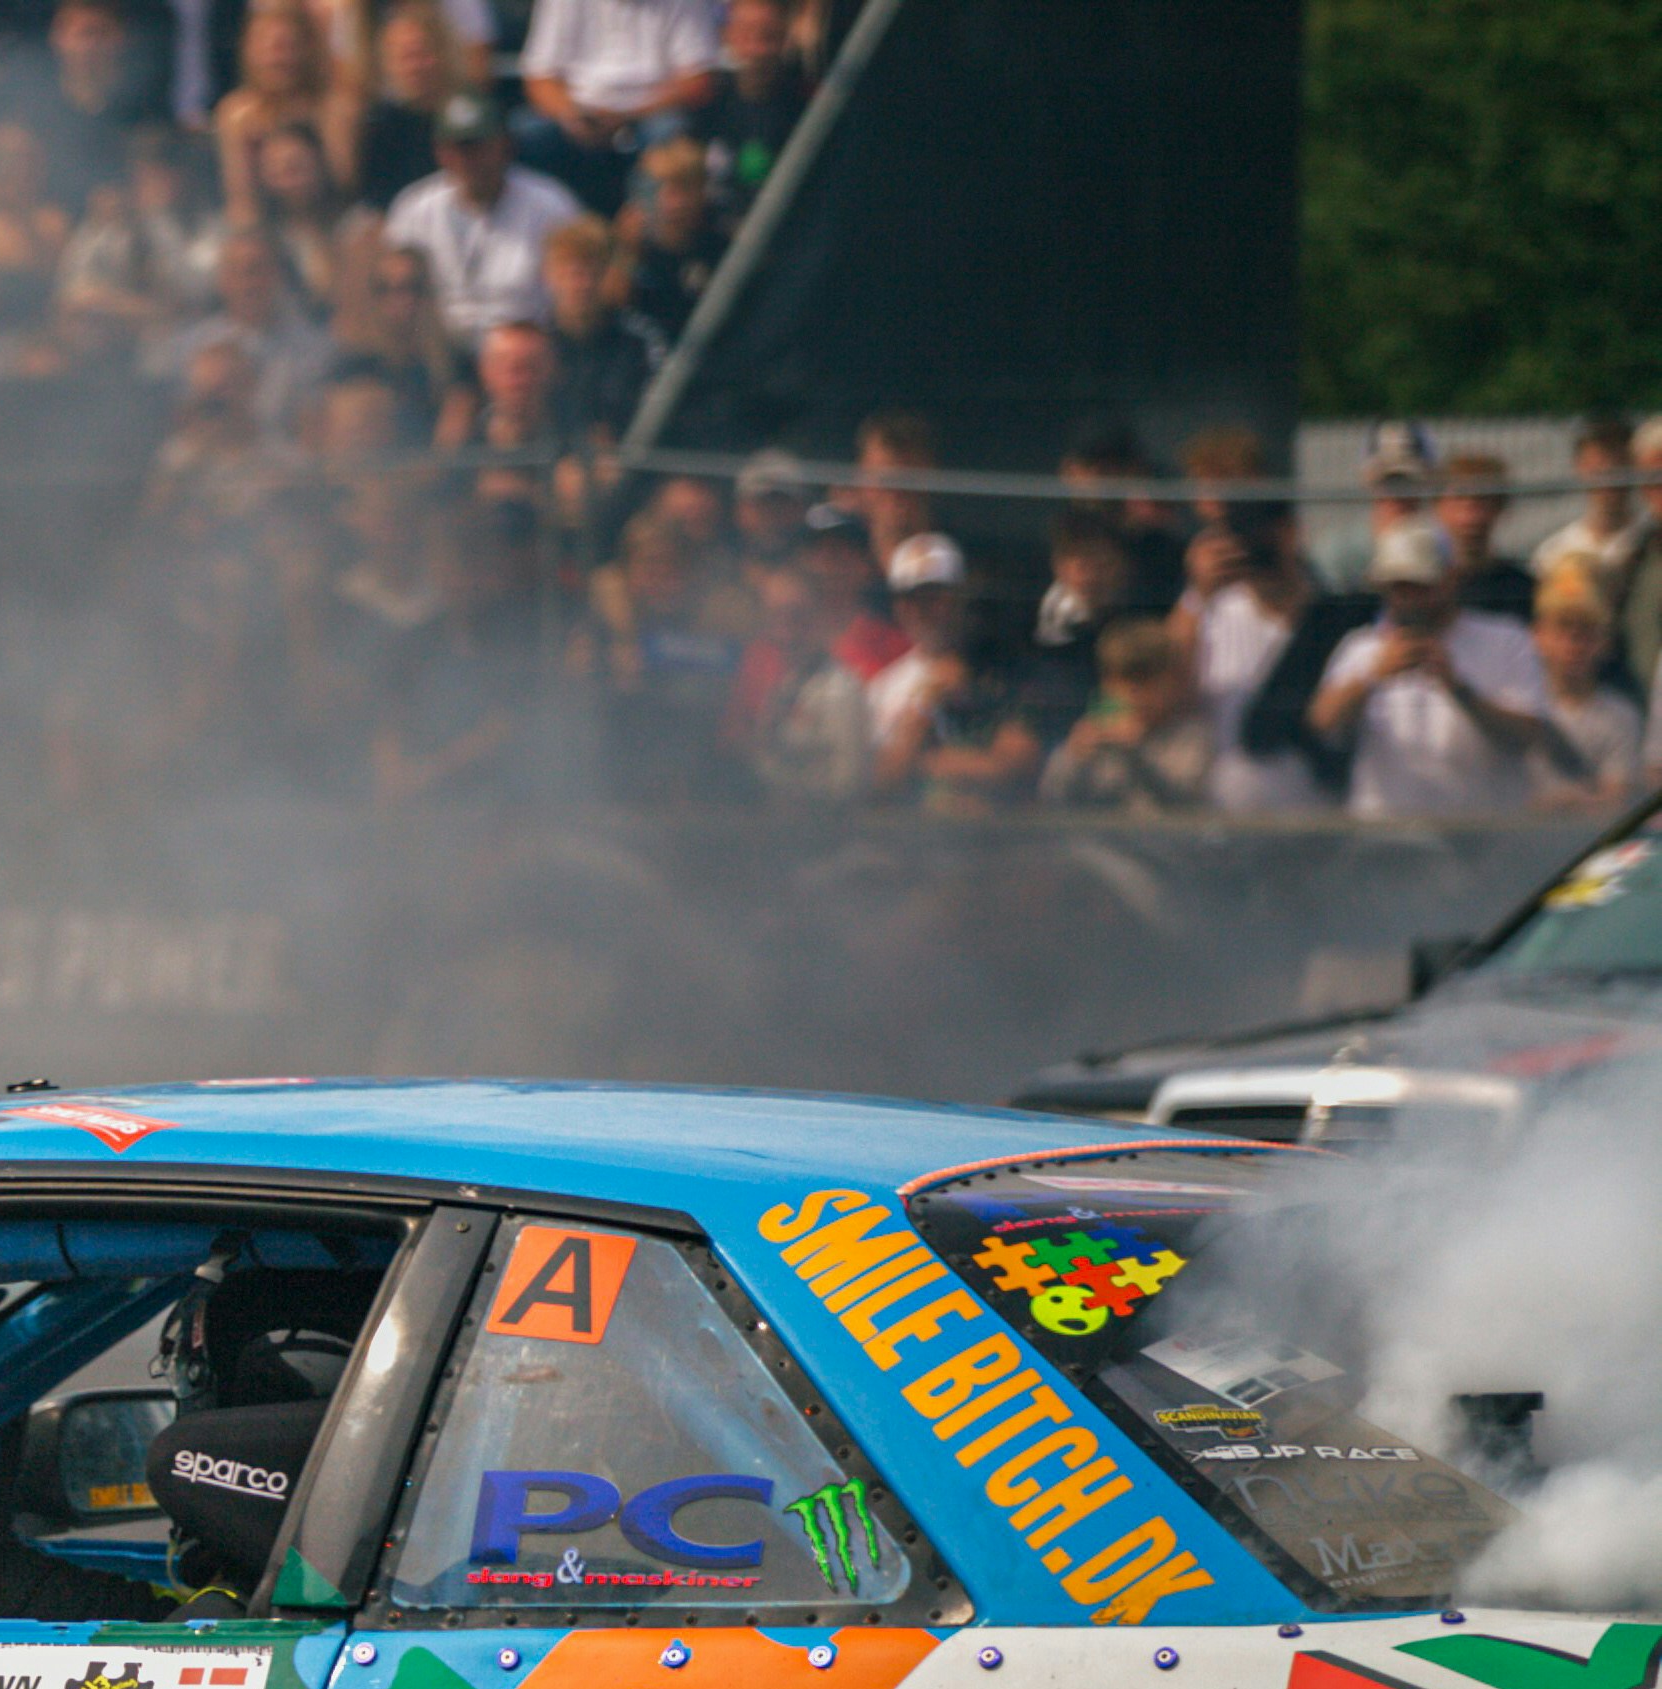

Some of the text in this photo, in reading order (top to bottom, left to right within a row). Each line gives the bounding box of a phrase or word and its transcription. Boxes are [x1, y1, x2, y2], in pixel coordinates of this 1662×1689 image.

[498, 1236, 593, 1334] A
[758, 1190, 983, 1371] SMILE
[900, 1331, 1215, 1625] BITCH.DK
[171, 1449, 289, 1499] sparco
[1232, 1444, 1420, 1461] BJP RACE
[469, 1470, 774, 1569] PC
[466, 1547, 761, 1588] slang & maskiner
